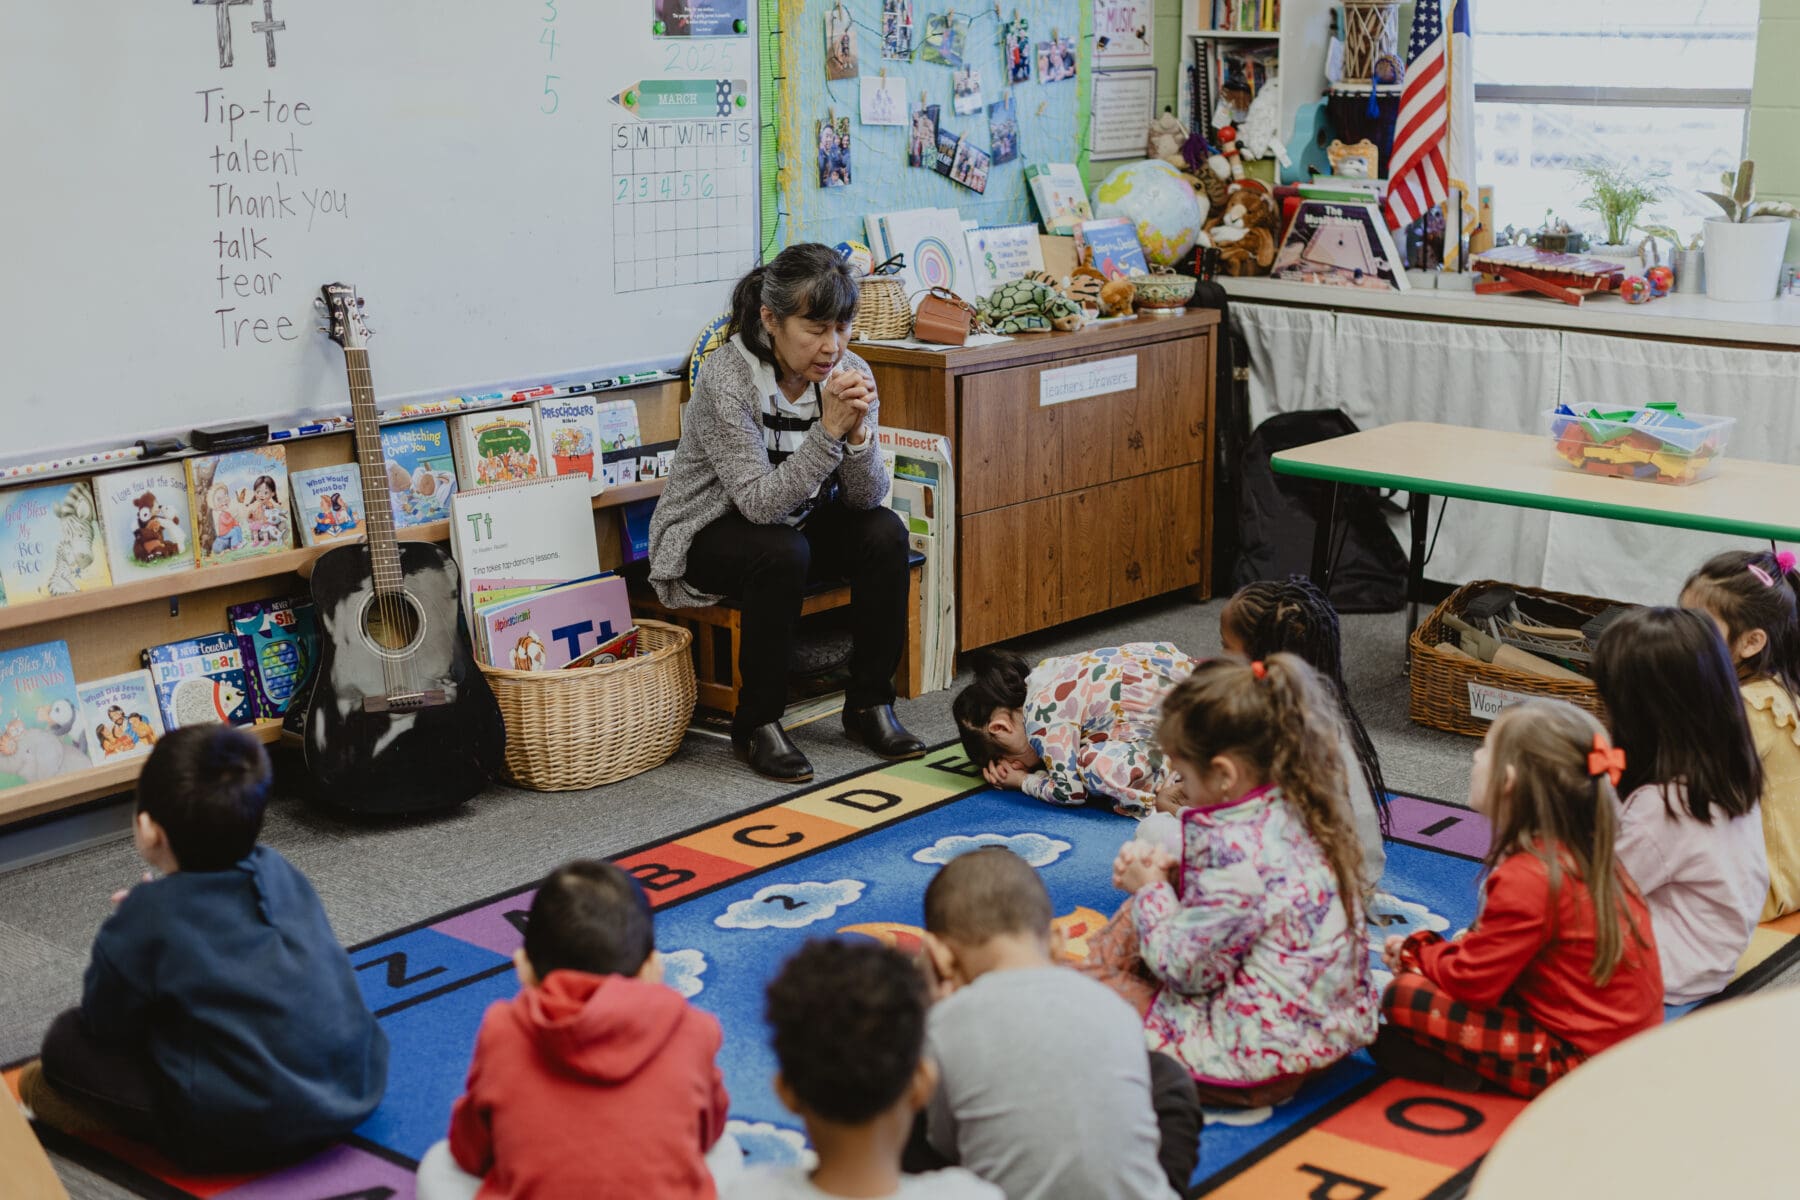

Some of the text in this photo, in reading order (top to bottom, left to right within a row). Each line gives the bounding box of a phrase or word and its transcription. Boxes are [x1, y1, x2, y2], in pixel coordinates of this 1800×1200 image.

[539, 28, 561, 62] 4
[664, 42, 737, 73] 2025
[540, 75, 561, 114] 5
[658, 93, 698, 105] MARCH
[195, 88, 313, 142] Tip-toe
[617, 122, 750, 149] S M T W TH F S
[209, 133, 303, 176] talent
[616, 173, 714, 200] 2 3 4 5 6
[209, 182, 349, 232] Thank you
[1324, 206, 1343, 216] The
[213, 227, 272, 261] talk
[216, 264, 282, 299] tear
[215, 308, 298, 349] Tree
[541, 405, 594, 419] PRESCHOOLERS
[398, 427, 442, 447] Watching
[894, 432, 938, 452] Insect?
[387, 444, 409, 457] Over
[306, 475, 349, 488] What Would
[312, 483, 347, 496] Jesus Do?
[26, 499, 48, 520] Bless
[486, 562, 502, 573] takes
[272, 601, 289, 611] NEVER
[180, 646, 200, 657] NEVER
[200, 637, 229, 656] touch
[202, 650, 240, 673] bear!
[106, 686, 120, 695] Did
[122, 684, 144, 692] Jesus
[826, 788, 904, 813] D
[732, 824, 805, 849] C
[1385, 1096, 1486, 1137] O
